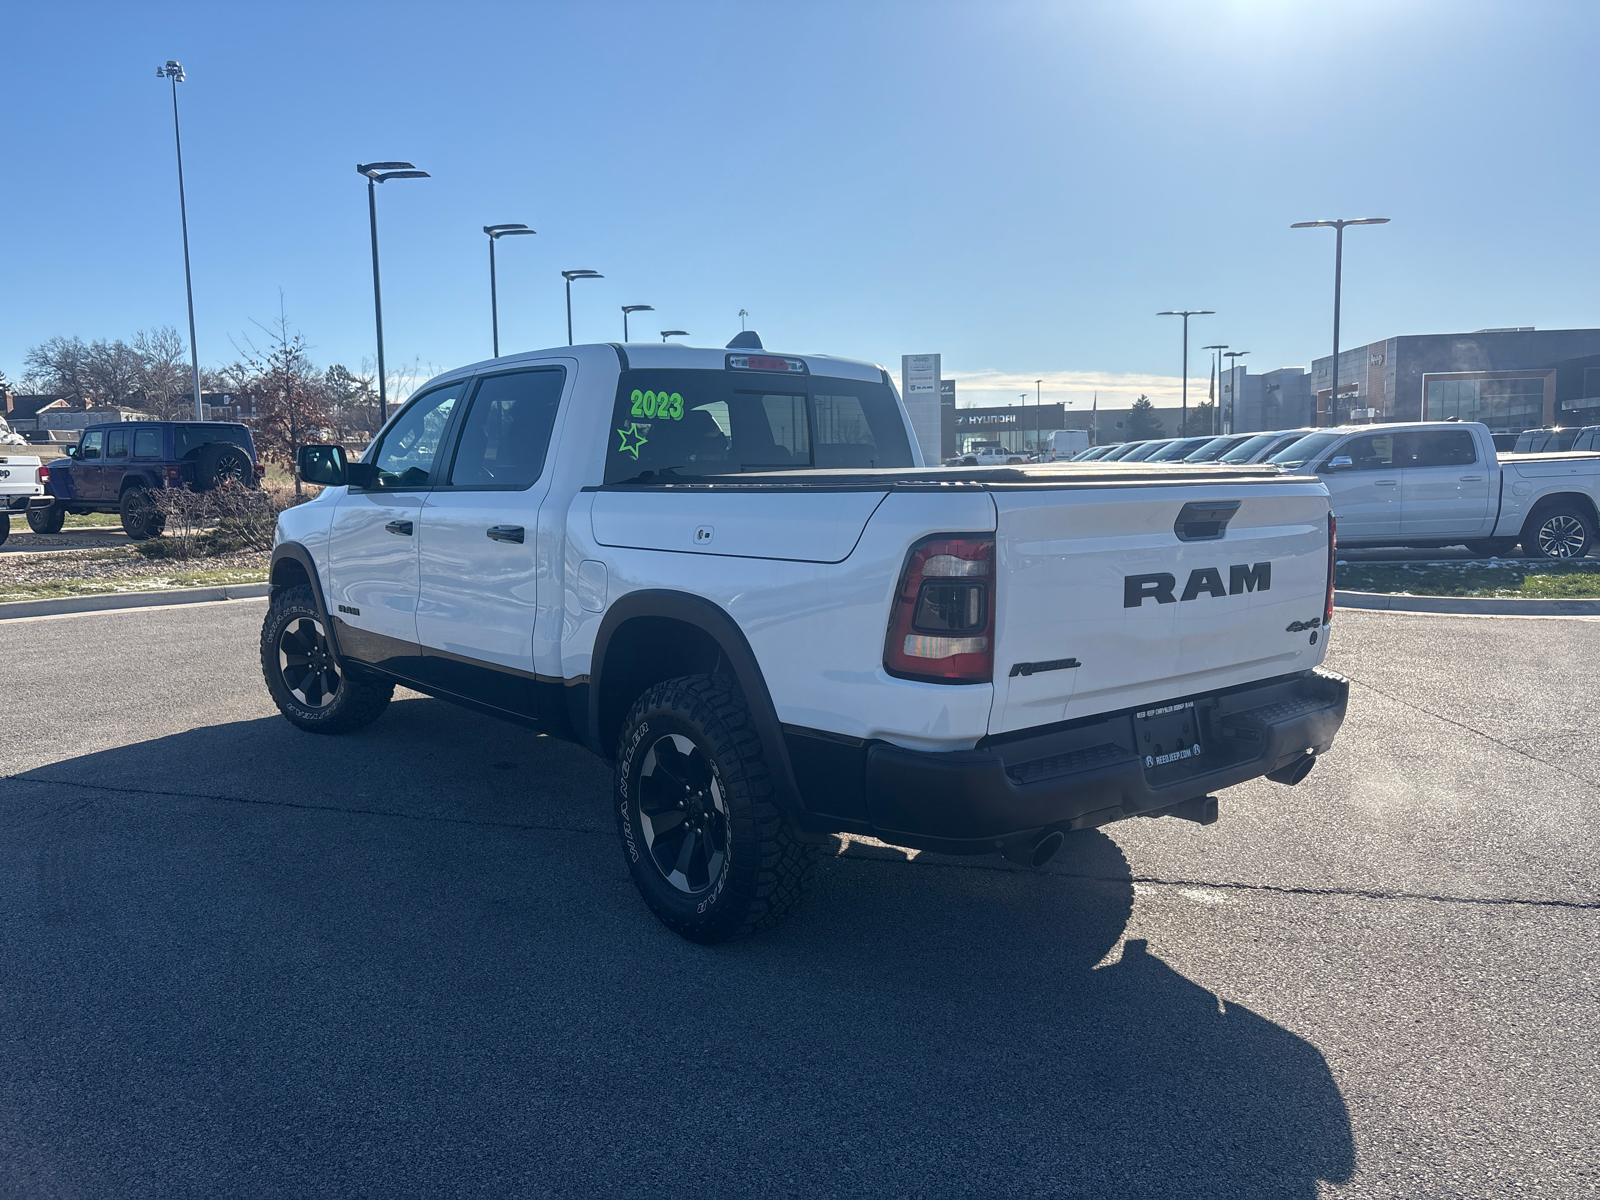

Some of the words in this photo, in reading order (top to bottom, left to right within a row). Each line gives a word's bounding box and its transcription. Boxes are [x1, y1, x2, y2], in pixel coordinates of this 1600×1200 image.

[630, 389, 685, 421] 2023
[968, 414, 1016, 425] HYUNDAI
[1124, 561, 1271, 608] RAM
[338, 604, 360, 616] RAM
[1008, 657, 1082, 677] REBEL
[1155, 748, 1192, 765] REEDJEEP.COM
[619, 721, 650, 863] WRANGLER
[696, 758, 733, 914] GOODYEAR
